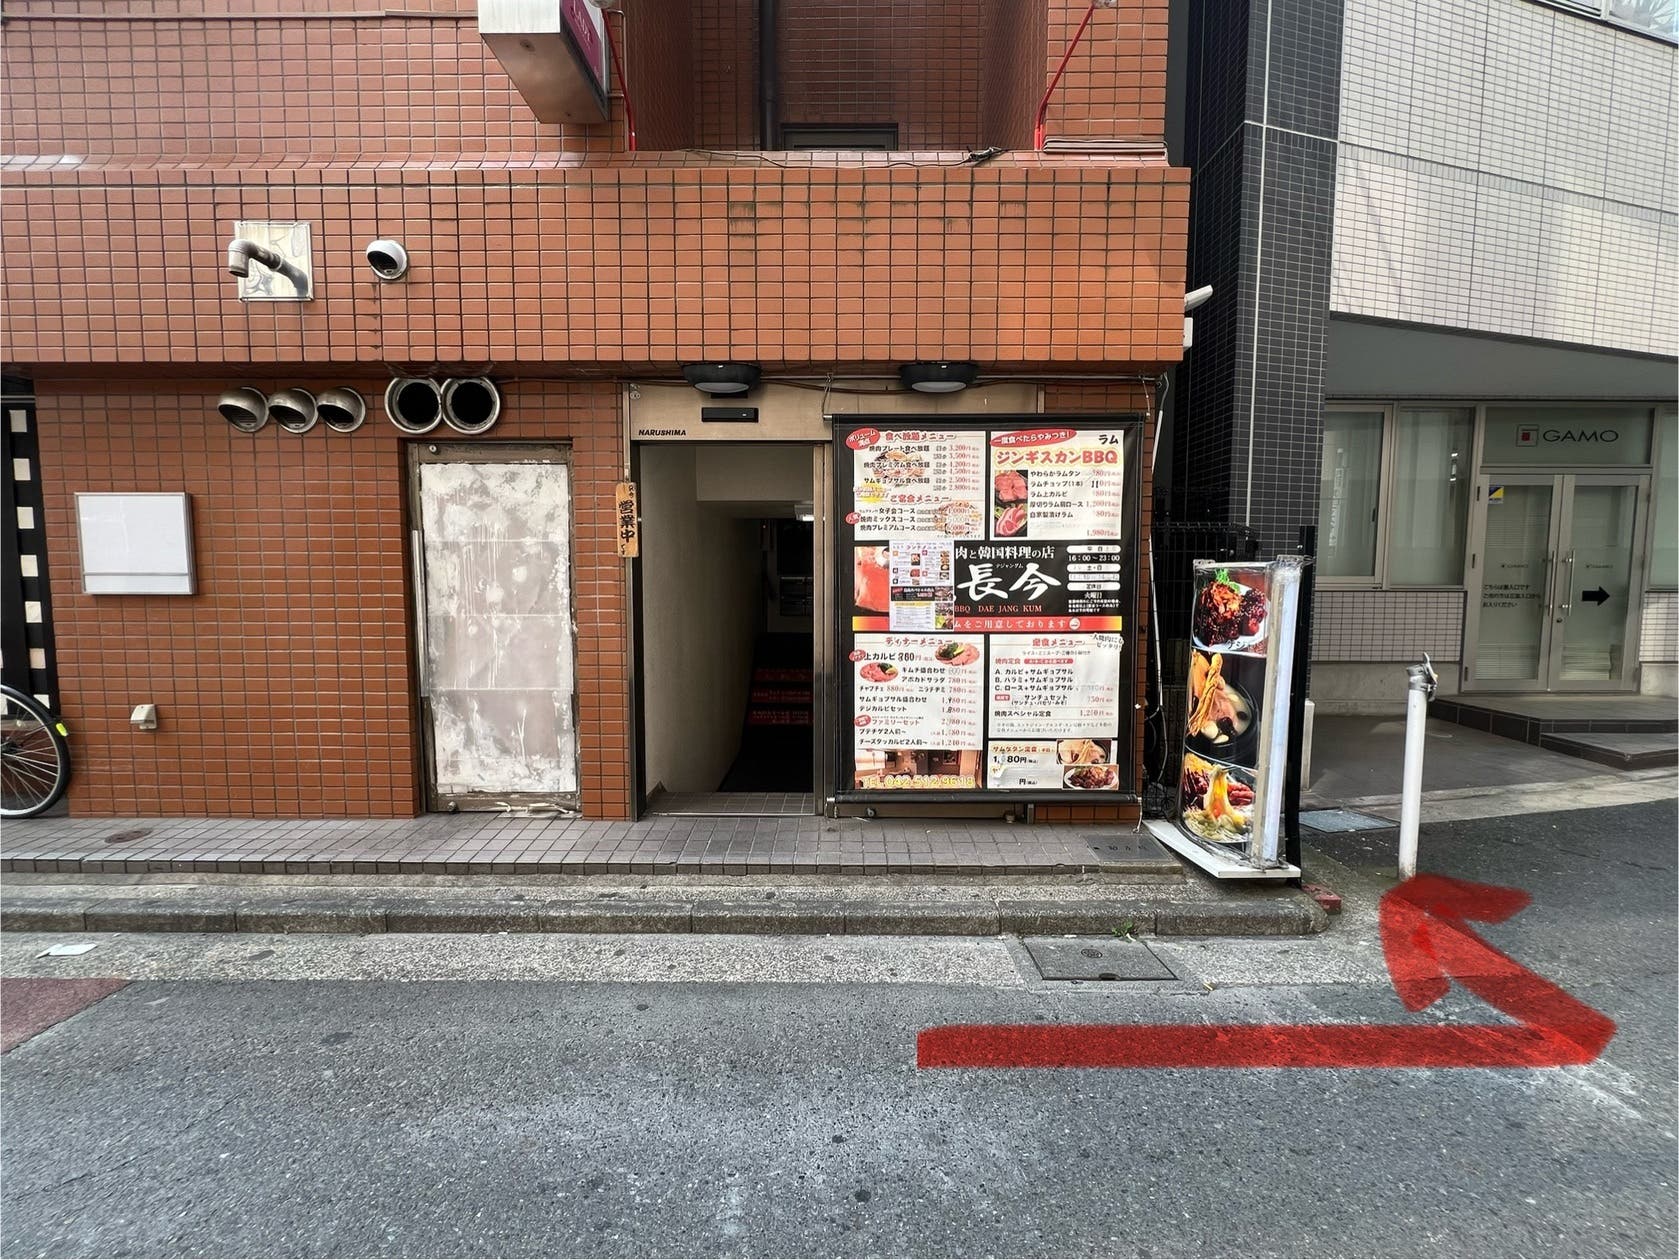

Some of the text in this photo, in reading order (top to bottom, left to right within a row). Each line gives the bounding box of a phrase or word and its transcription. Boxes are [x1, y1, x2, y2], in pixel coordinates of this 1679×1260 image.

[885, 432, 954, 441] 食べ放題メニュー
[1098, 435, 1119, 445] ラム
[1543, 430, 1618, 442] GAMO
[997, 450, 1118, 464] ジンギスカンBBQ
[619, 500, 635, 543] 営業中
[955, 546, 1055, 559] 肉と韓国料理の店
[955, 562, 1062, 601] 長今
[886, 637, 953, 646] ディナーメニュー
[1032, 638, 1083, 646] 定食メニュー
